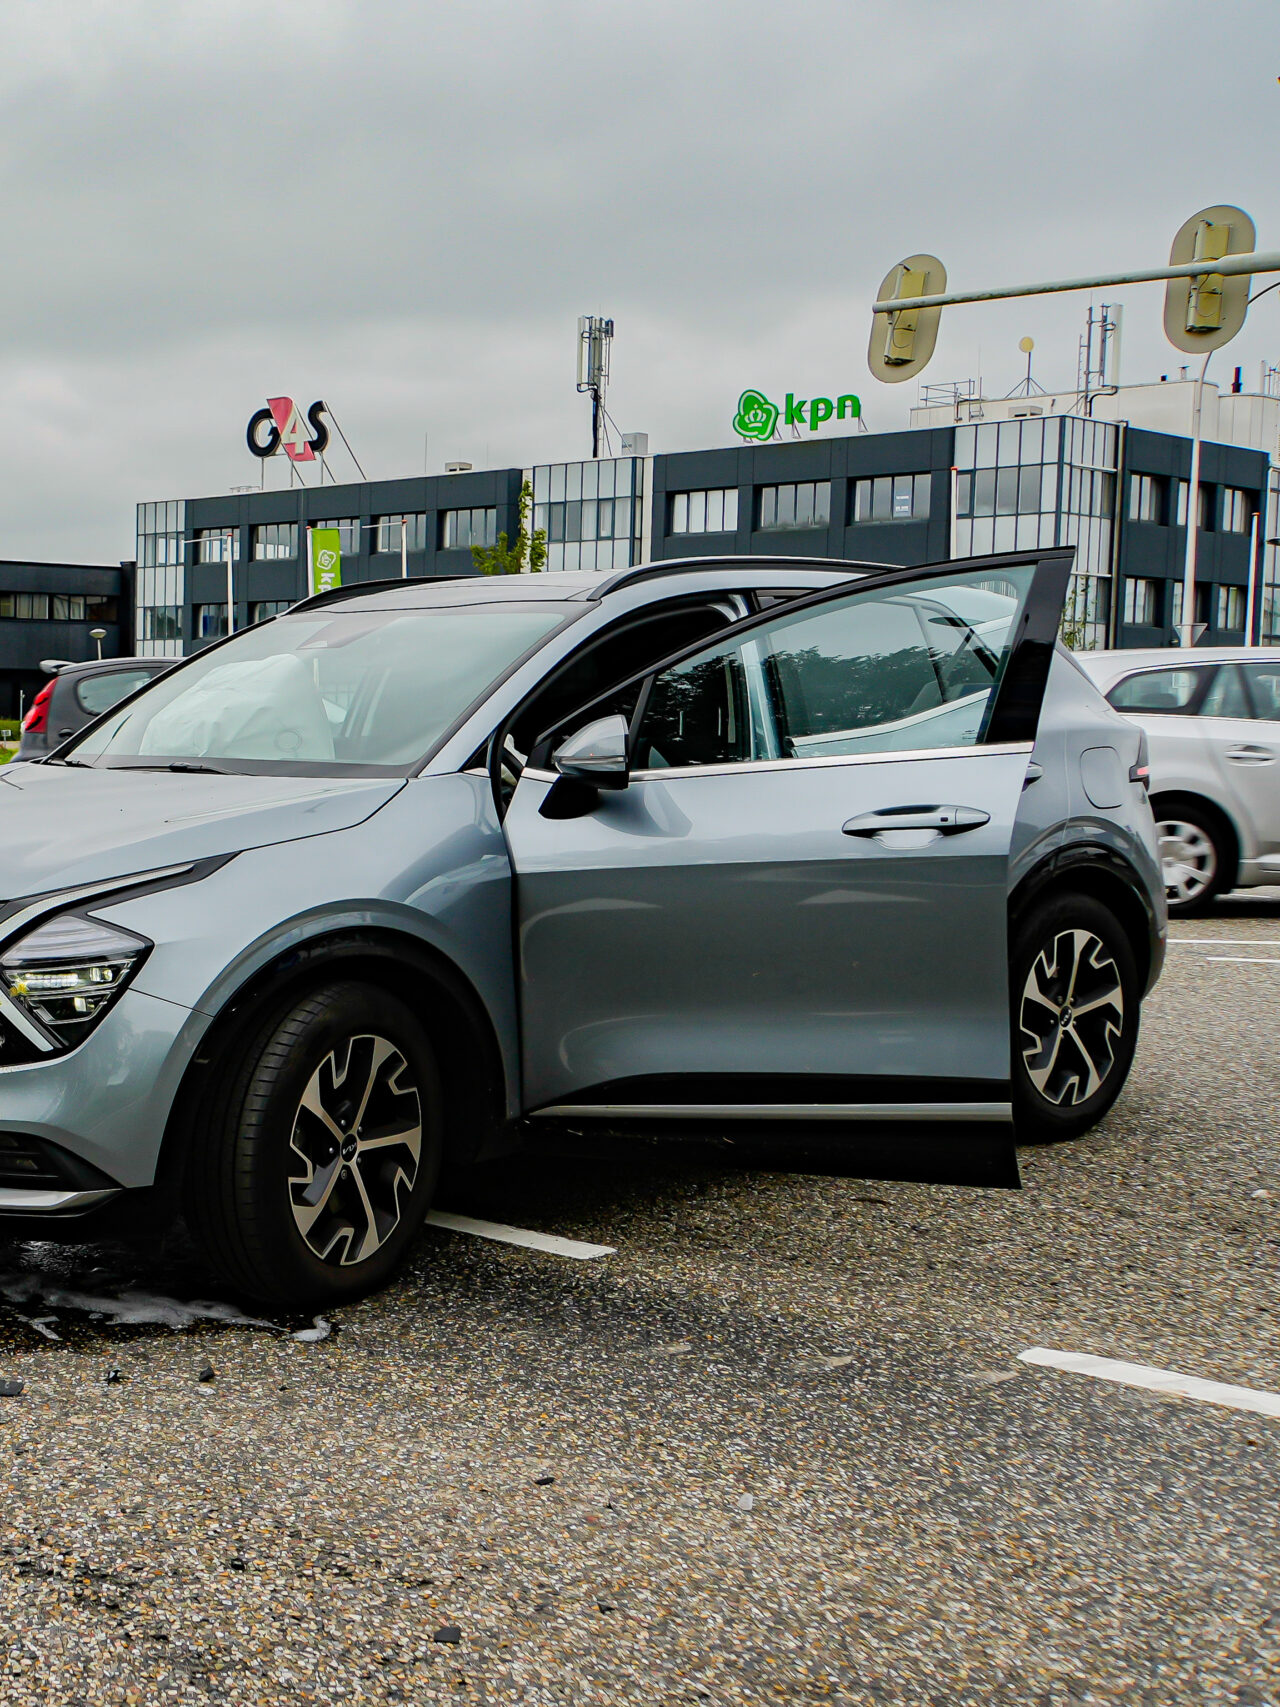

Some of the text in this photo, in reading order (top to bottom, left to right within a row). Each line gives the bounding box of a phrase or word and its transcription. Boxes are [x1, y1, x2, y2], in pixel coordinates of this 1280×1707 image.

[247, 397, 328, 461] G4S
[785, 393, 861, 431] kpn
[317, 572, 336, 593] kp
